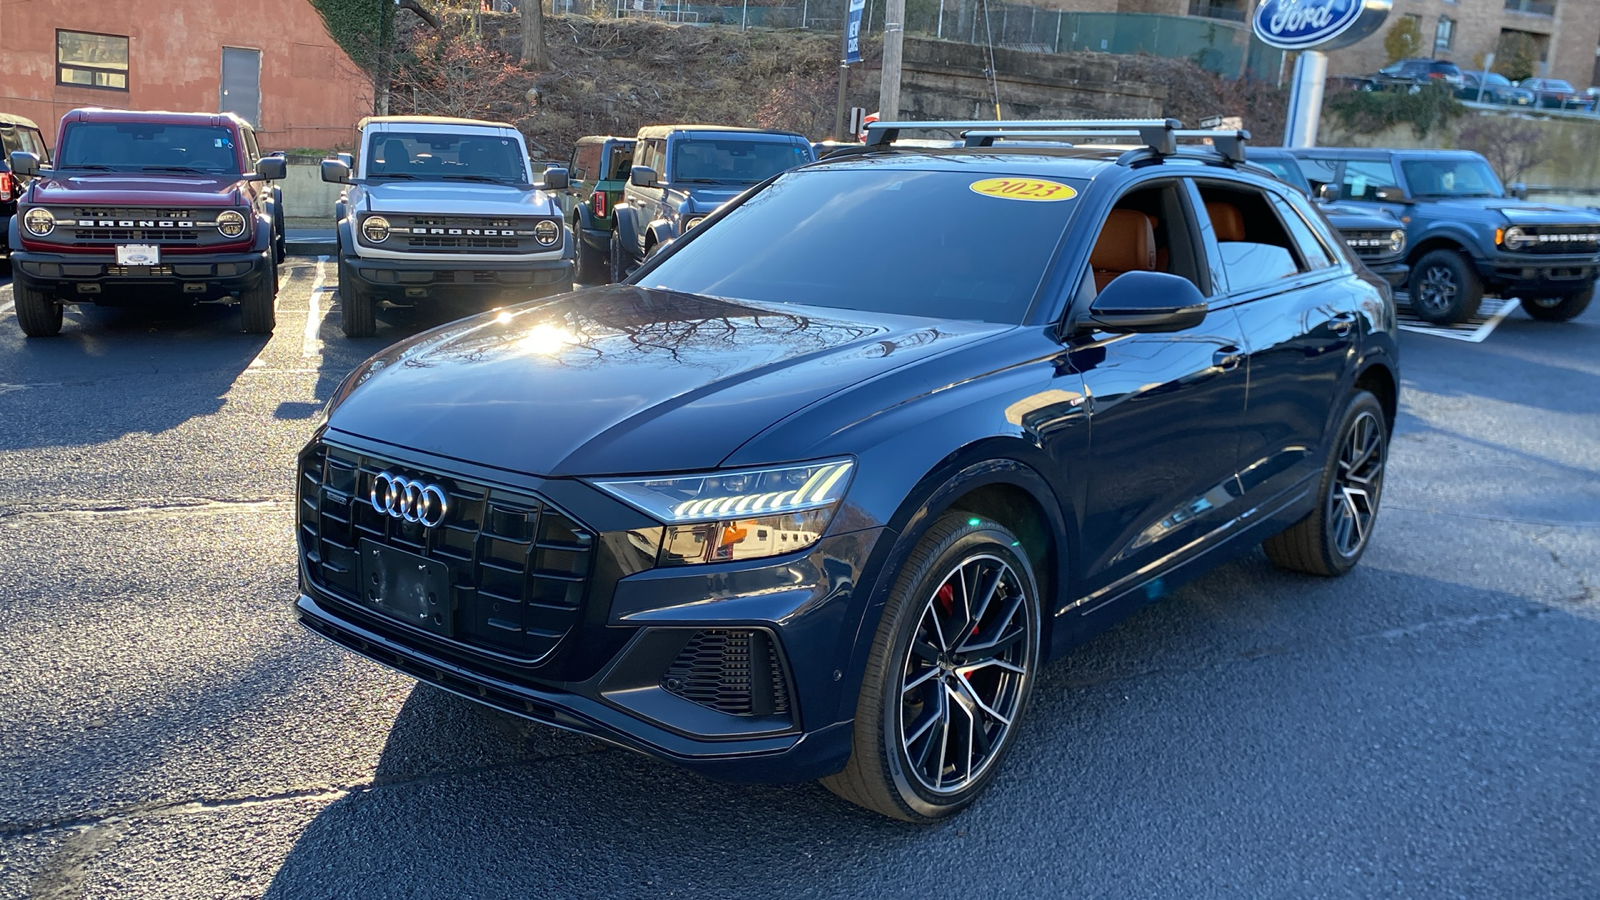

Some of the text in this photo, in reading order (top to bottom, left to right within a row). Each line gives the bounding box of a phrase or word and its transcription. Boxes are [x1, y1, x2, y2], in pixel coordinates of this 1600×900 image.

[1270, 0, 1333, 34] Ford
[983, 181, 1062, 197] 2023
[413, 228, 514, 236] BRONCO
